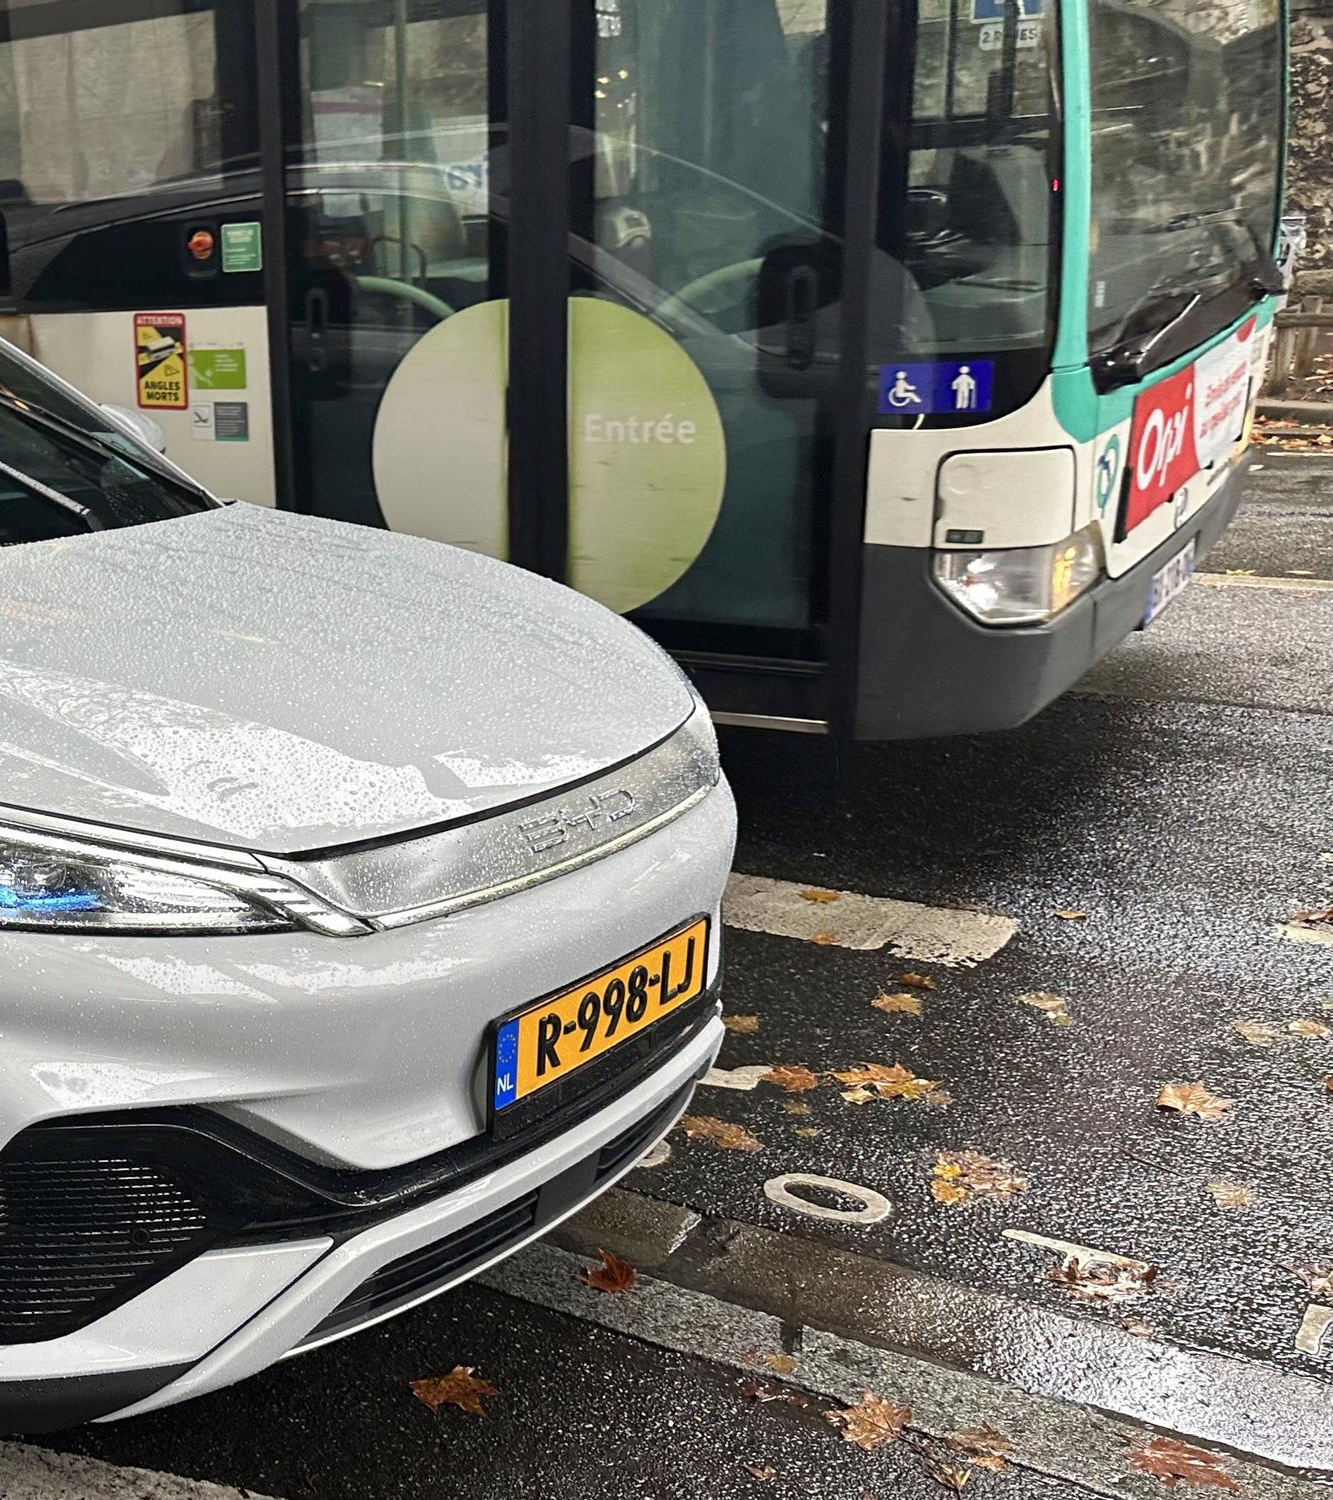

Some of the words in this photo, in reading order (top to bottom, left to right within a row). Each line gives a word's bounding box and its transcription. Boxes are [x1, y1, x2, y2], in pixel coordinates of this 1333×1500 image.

[982, 31, 991, 44] 2
[994, 28, 1038, 42] RES
[144, 380, 180, 391] ANGLES
[146, 391, 180, 402] MORTS
[585, 412, 696, 444] Entrée
[518, 787, 636, 855] BYD
[536, 935, 696, 1077] R-998-LJ
[496, 1073, 514, 1096] NL
